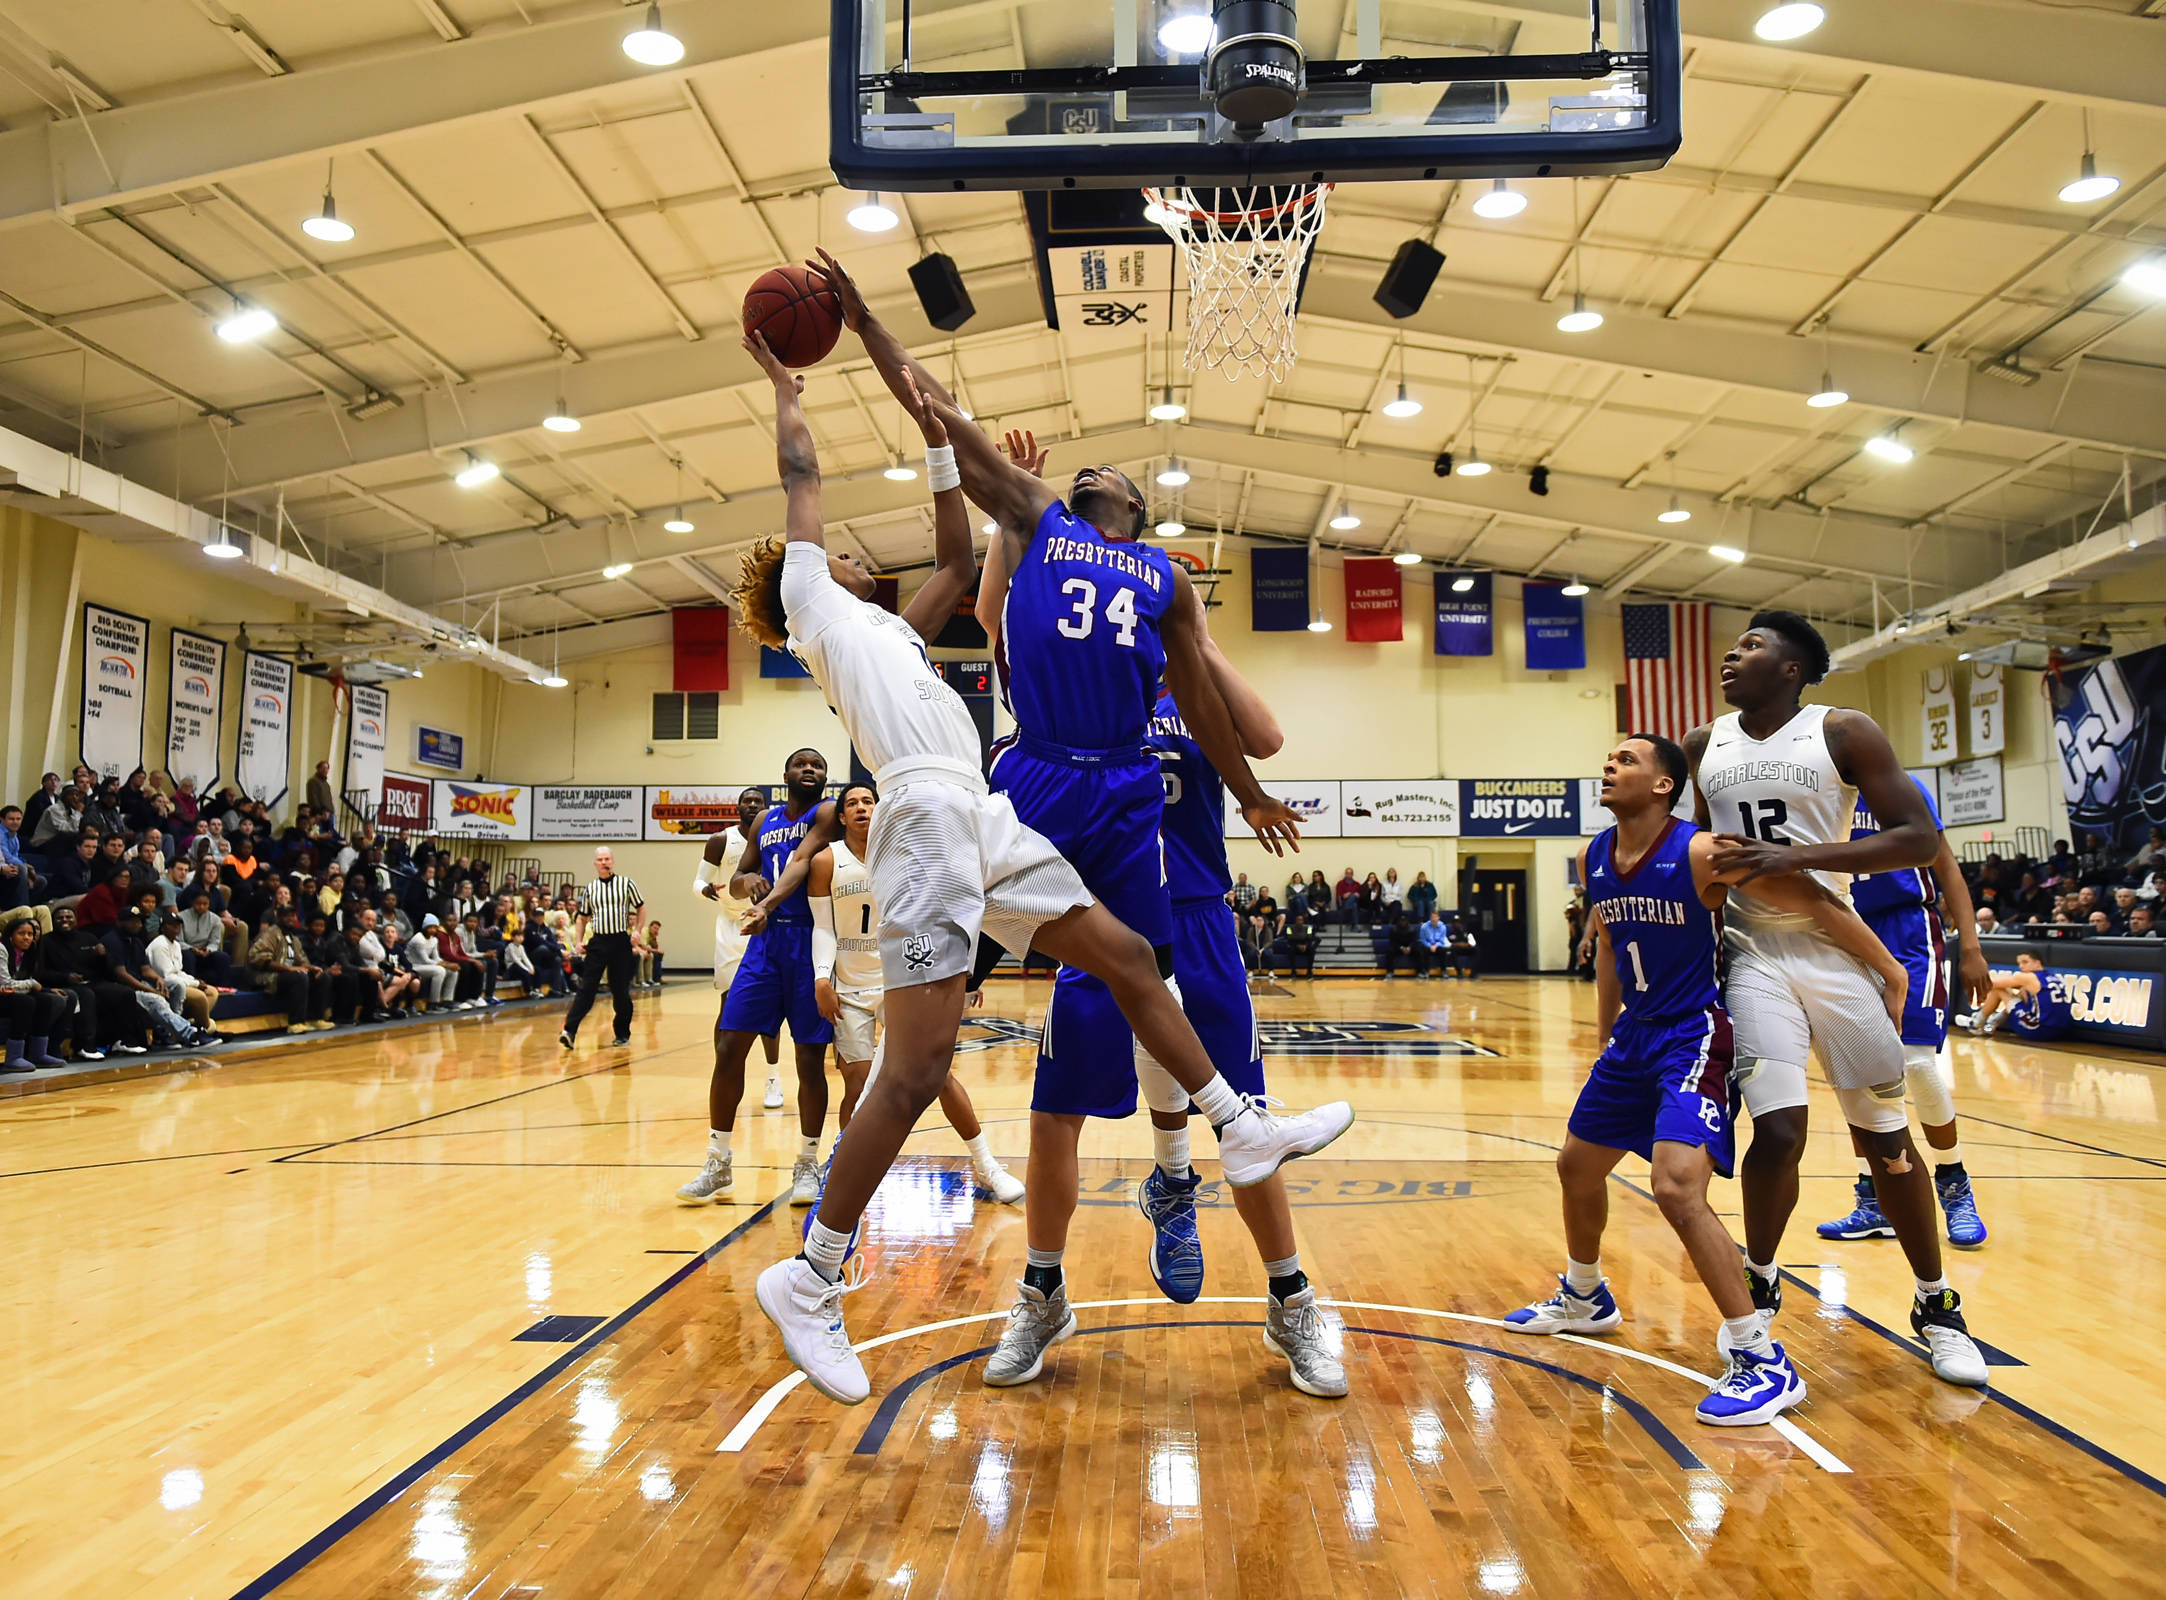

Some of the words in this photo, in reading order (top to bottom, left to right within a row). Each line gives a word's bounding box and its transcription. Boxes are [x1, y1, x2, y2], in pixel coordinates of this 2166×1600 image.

[1246, 64, 1296, 84] SPALDING
[1063, 108, 1099, 133] CSU
[1043, 537, 1161, 594] PRESBYTERIAN
[1355, 588, 1393, 598] RADFORD
[1057, 578, 1138, 648] 34
[1351, 600, 1400, 609] UNIVERSITY
[97, 615, 111, 626] BIG
[112, 619, 137, 633] SOUTH
[1439, 614, 1488, 624] UNIVERSITY
[92, 625, 140, 646] CONFERENCE
[961, 663, 988, 672] GUEST
[977, 676, 988, 690] 2
[1982, 709, 1991, 740] 3
[1931, 720, 1948, 751] 32
[1475, 781, 1567, 796] BUCCANEERS
[1708, 760, 1819, 799] CHARLESTON
[386, 788, 423, 819] BB&T
[453, 795, 515, 815] SONIC
[544, 790, 580, 800] BARCLAY
[584, 790, 632, 800] RADEBAUGH
[556, 799, 596, 810] Basketball
[598, 798, 619, 811] Camp
[1375, 798, 1394, 810] Rug
[1396, 794, 1437, 805] Masters,
[1439, 798, 1456, 812] Inc.
[656, 808, 694, 817] WILLIE
[1381, 814, 1452, 822] 843.723.2155
[1470, 799, 1514, 819] JUST
[1517, 799, 1545, 819] DO
[1547, 799, 1572, 819] IT.
[461, 822, 498, 830] America's
[1738, 799, 1792, 846] 12
[861, 904, 871, 934] 1
[903, 934, 933, 960] CSU
[1627, 941, 1649, 992] 1
[1338, 1180, 1473, 1195] BIG
